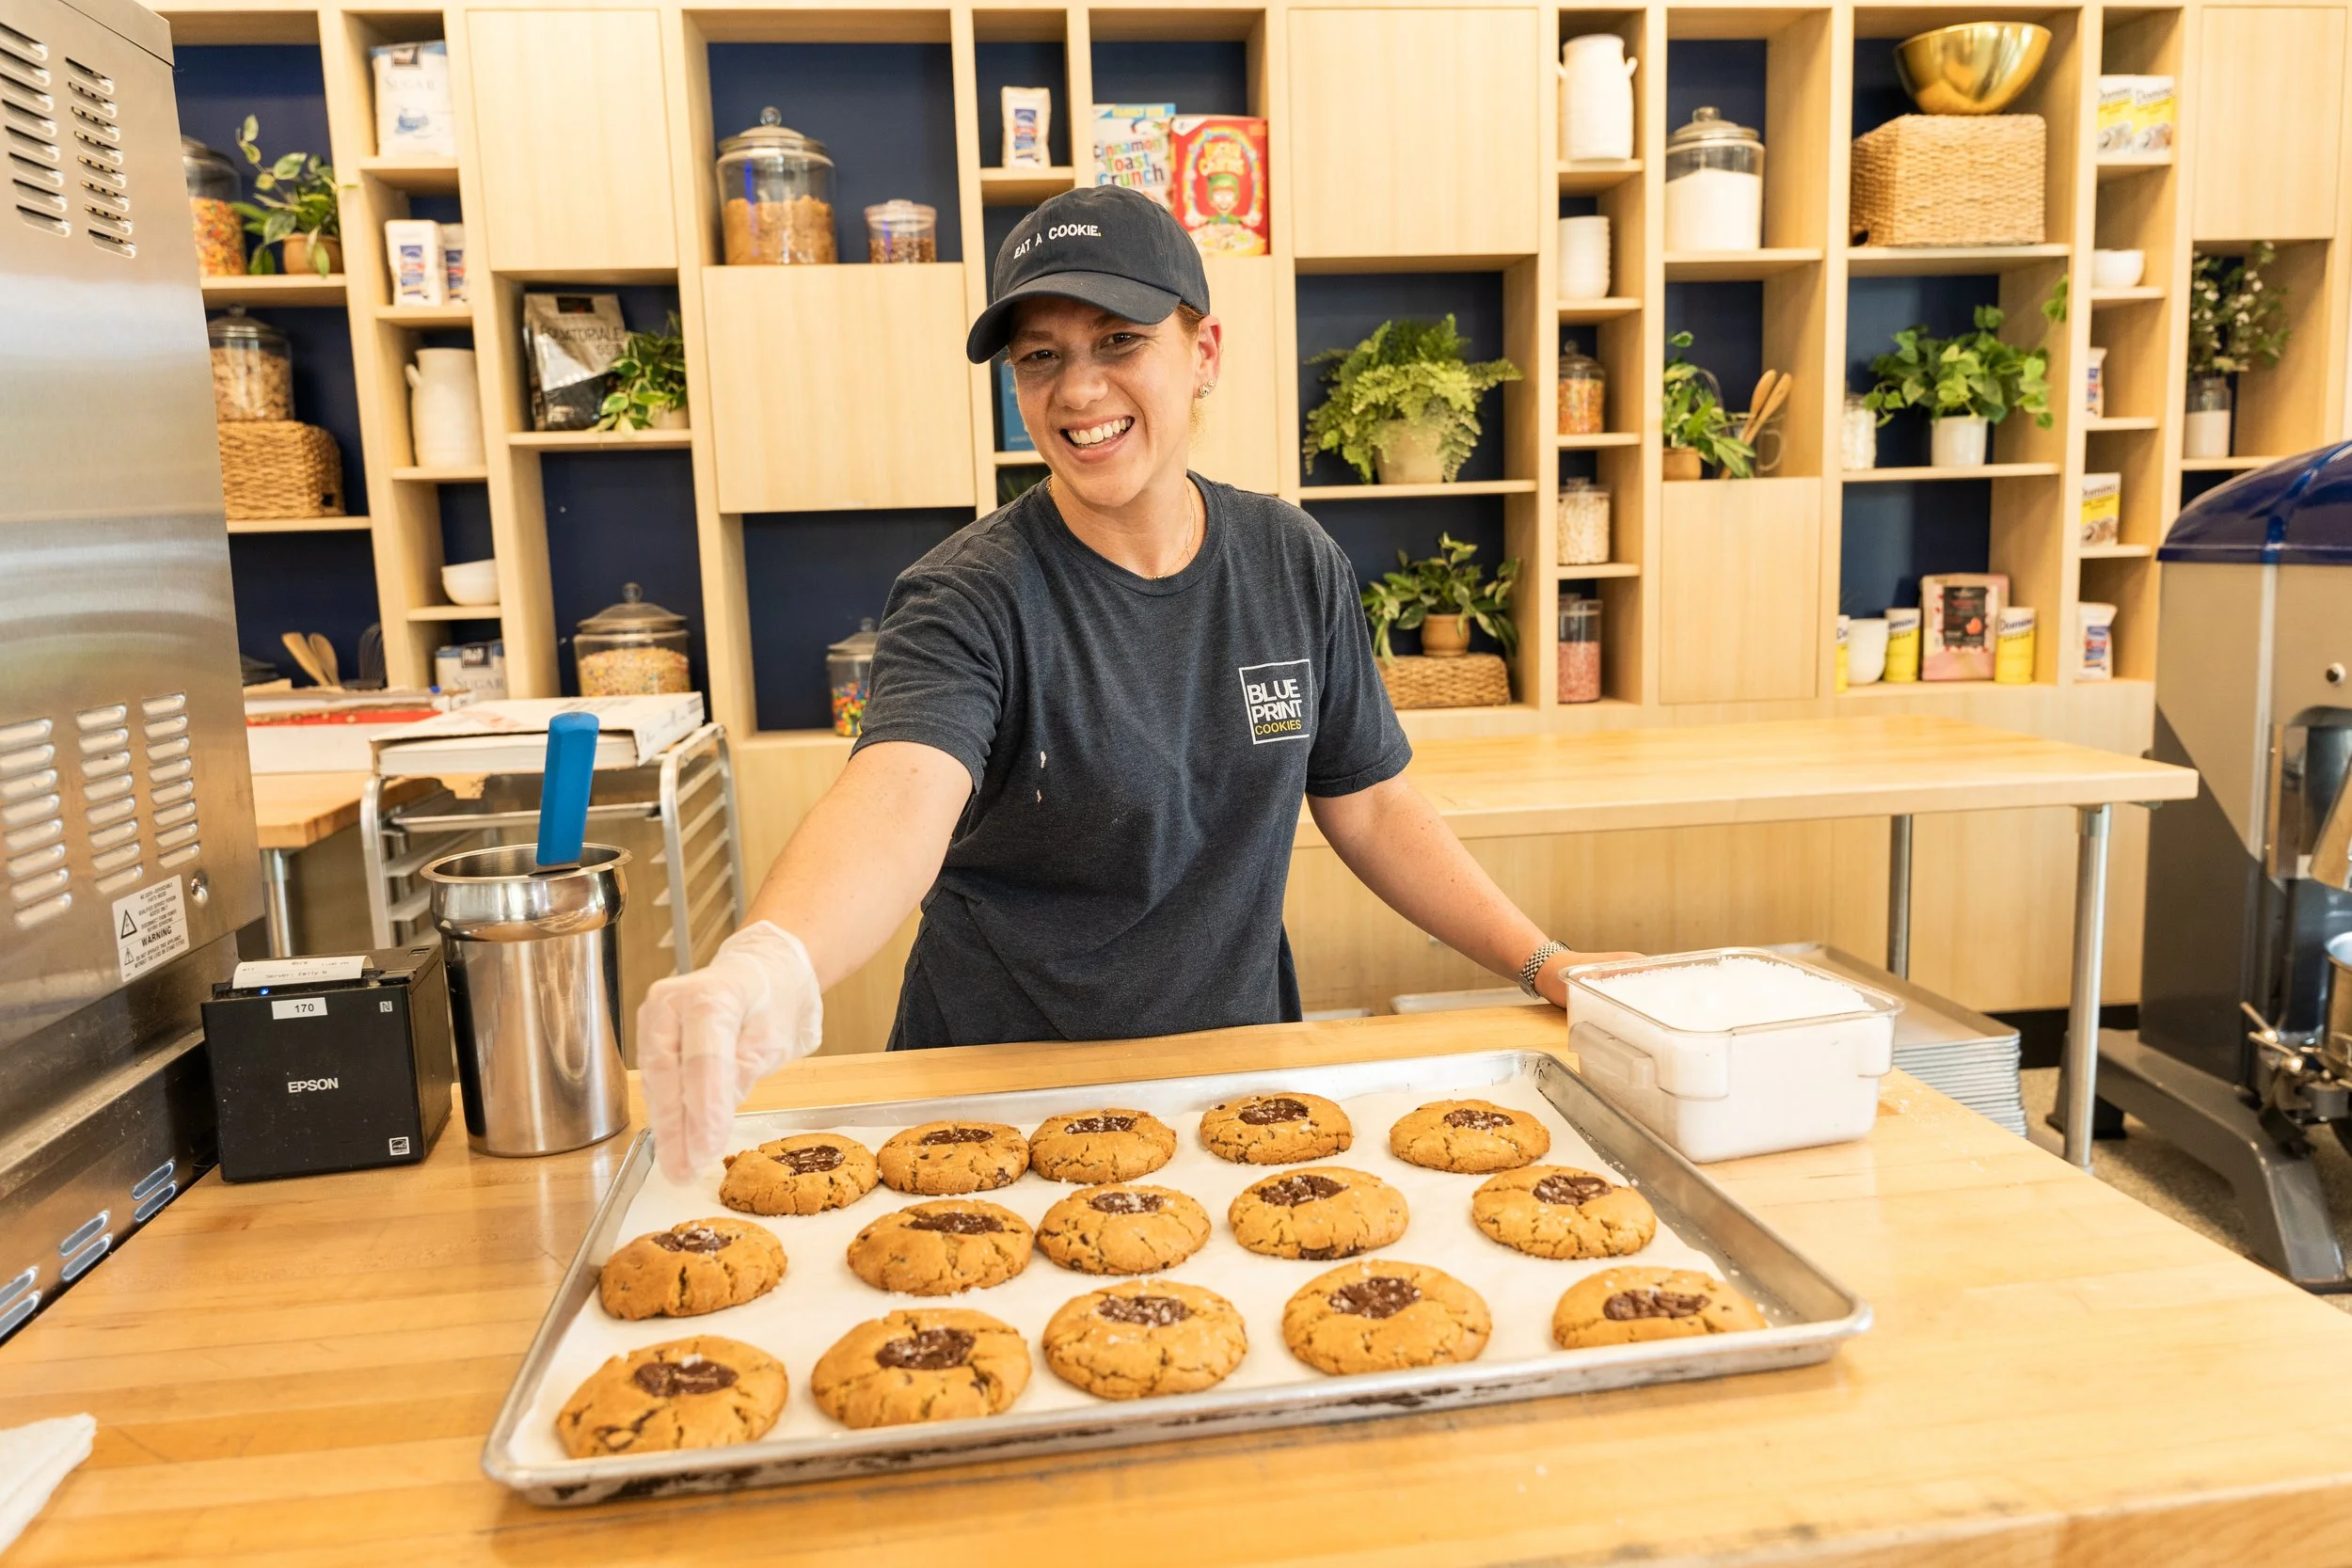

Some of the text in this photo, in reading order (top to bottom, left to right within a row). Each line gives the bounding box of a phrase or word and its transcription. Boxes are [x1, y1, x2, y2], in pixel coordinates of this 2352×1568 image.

[1013, 224, 1102, 260] EAT A COOKIE.
[1247, 678, 1301, 705] BLUE
[1250, 699, 1303, 723] PRINT
[1254, 720, 1302, 736] COOKIES
[141, 926, 172, 947] WARNING
[294, 1003, 315, 1014] 170
[288, 1077, 339, 1093] EPSON
